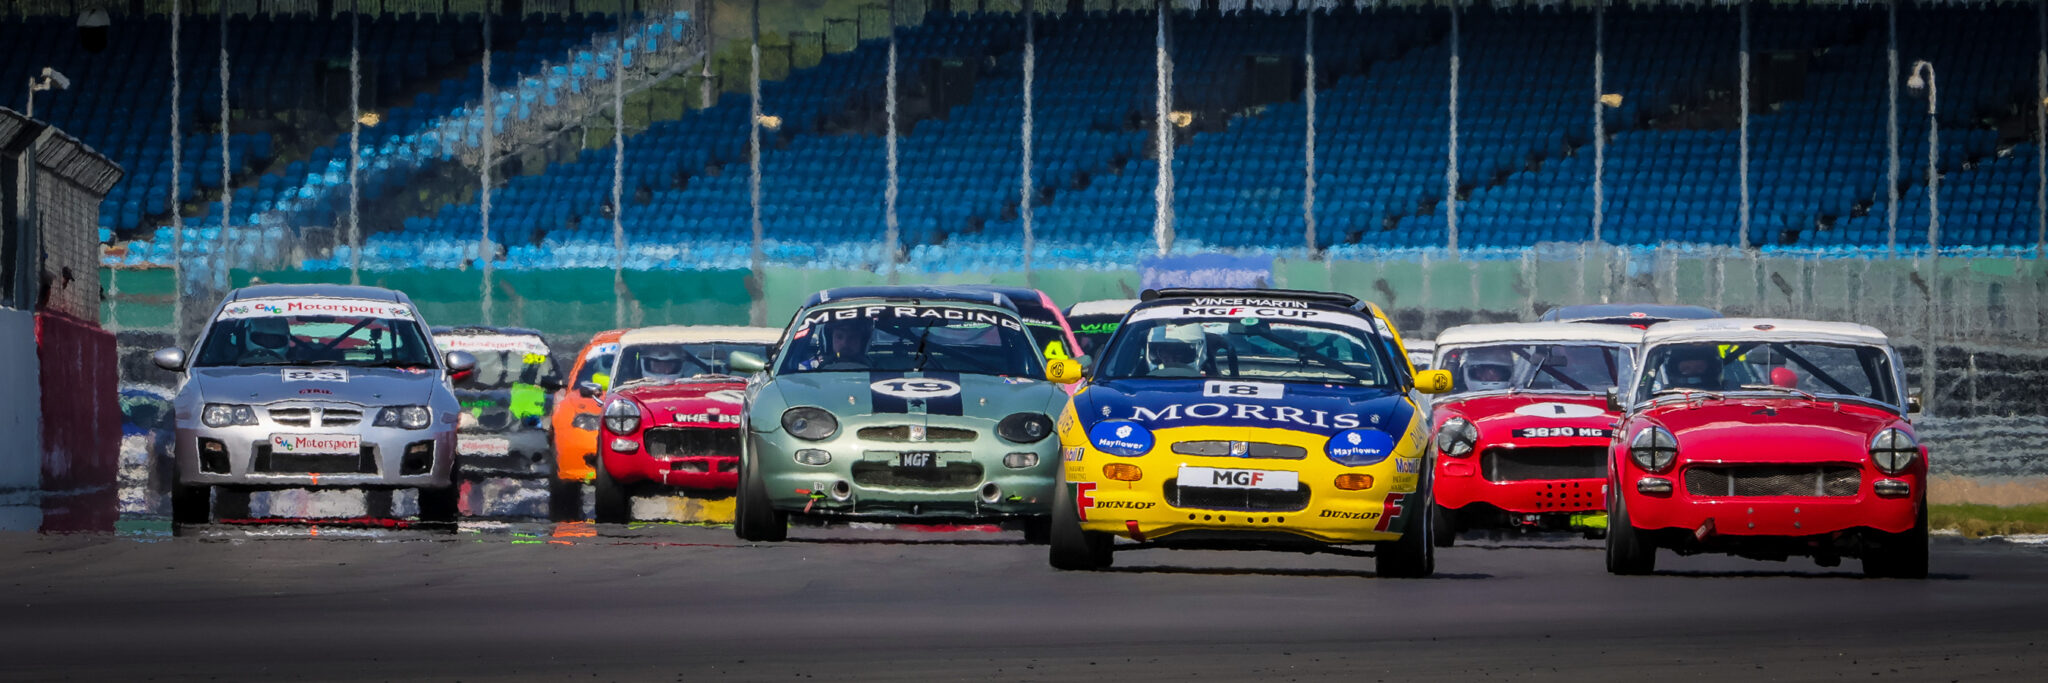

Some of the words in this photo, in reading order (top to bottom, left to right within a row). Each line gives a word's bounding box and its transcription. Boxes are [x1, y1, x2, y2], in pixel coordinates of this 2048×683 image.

[255, 303, 283, 314] CMC
[287, 302, 384, 314] Motorsport
[1194, 297, 1242, 307] VINCE
[1246, 298, 1308, 309] MARTIN
[1183, 307, 1245, 316] MGF
[1255, 308, 1319, 319] CUP
[1211, 383, 1259, 396] 18
[1128, 402, 1361, 429] MORRIS
[1553, 405, 1567, 415] 1
[1578, 427, 1603, 437] MG
[274, 436, 294, 451] CMC
[1098, 438, 1144, 450] Mayflower
[1333, 447, 1381, 456] Mayflower
[903, 453, 931, 467] MGF
[1212, 470, 1265, 487] MGF
[1096, 500, 1156, 510] DUNLOP
[1318, 509, 1382, 520] DUNLOP
